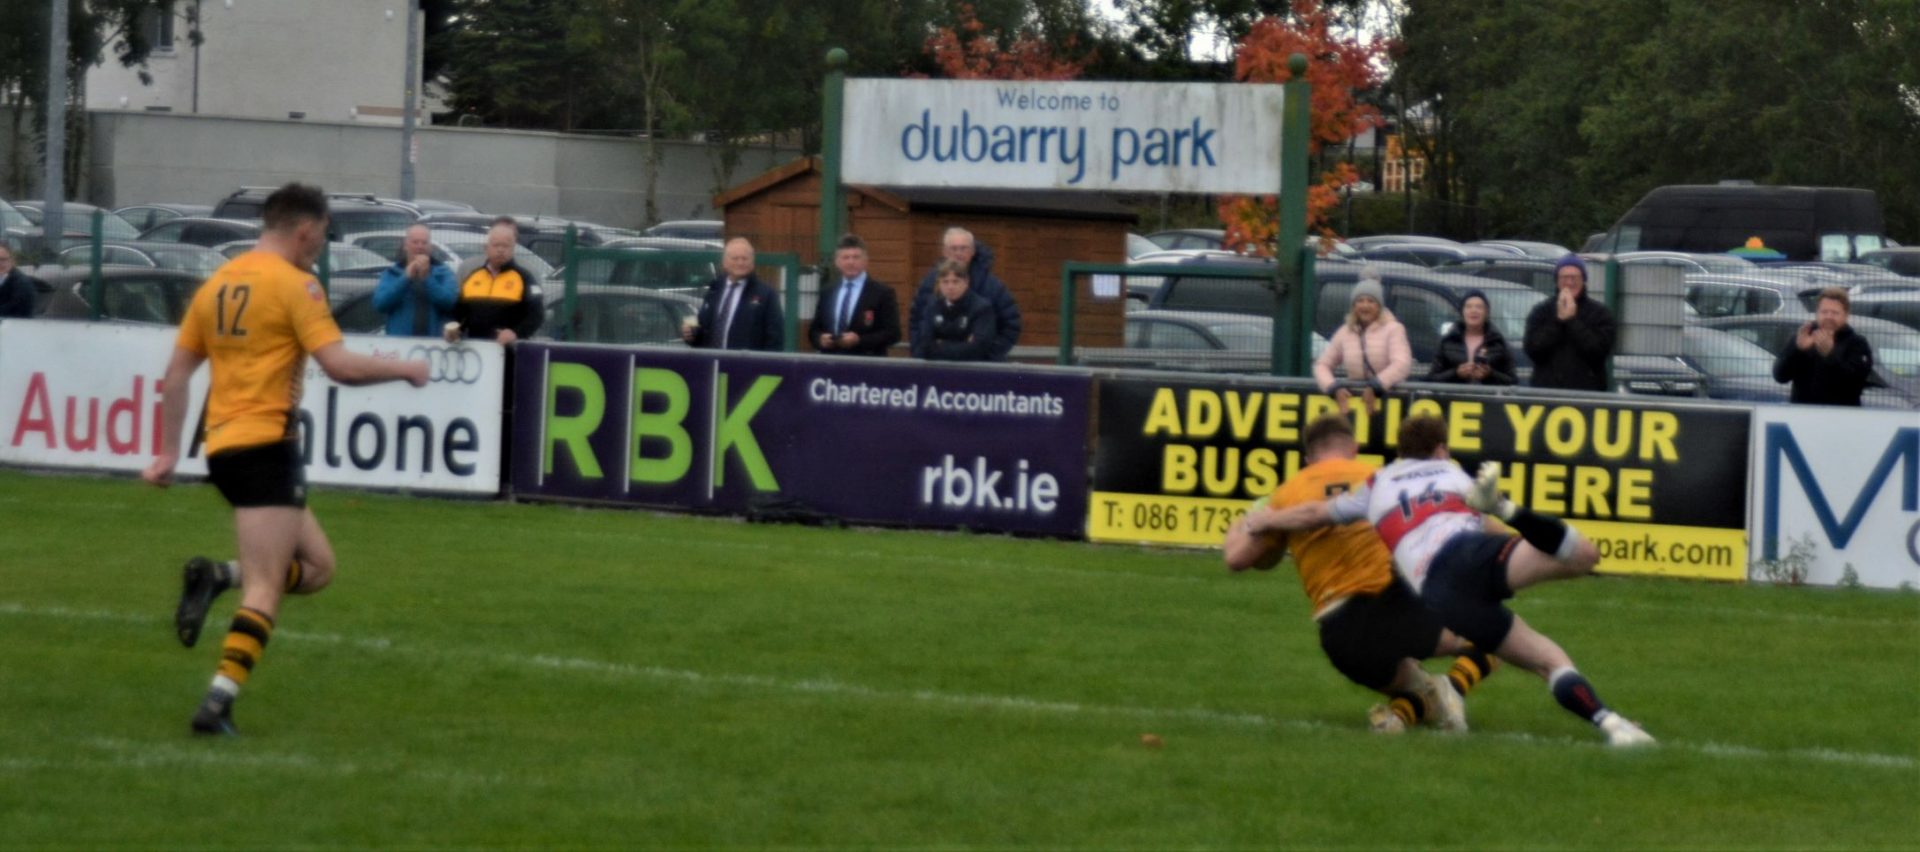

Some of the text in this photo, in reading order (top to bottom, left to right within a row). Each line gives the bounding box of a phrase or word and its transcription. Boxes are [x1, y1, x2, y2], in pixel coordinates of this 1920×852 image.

[997, 87, 1121, 111] Welcome to
[901, 108, 1216, 184] dubarry park
[216, 283, 251, 336] 12
[11, 371, 165, 457] Audi
[810, 378, 1063, 416] Chartered Accountants
[541, 361, 783, 492] RBK
[1504, 404, 1679, 461] YOUR
[923, 454, 1060, 512] rbk.ie
[1398, 481, 1444, 519] 14
[1103, 500, 1246, 534] T: 086 173
[1589, 533, 1732, 567] park.com
